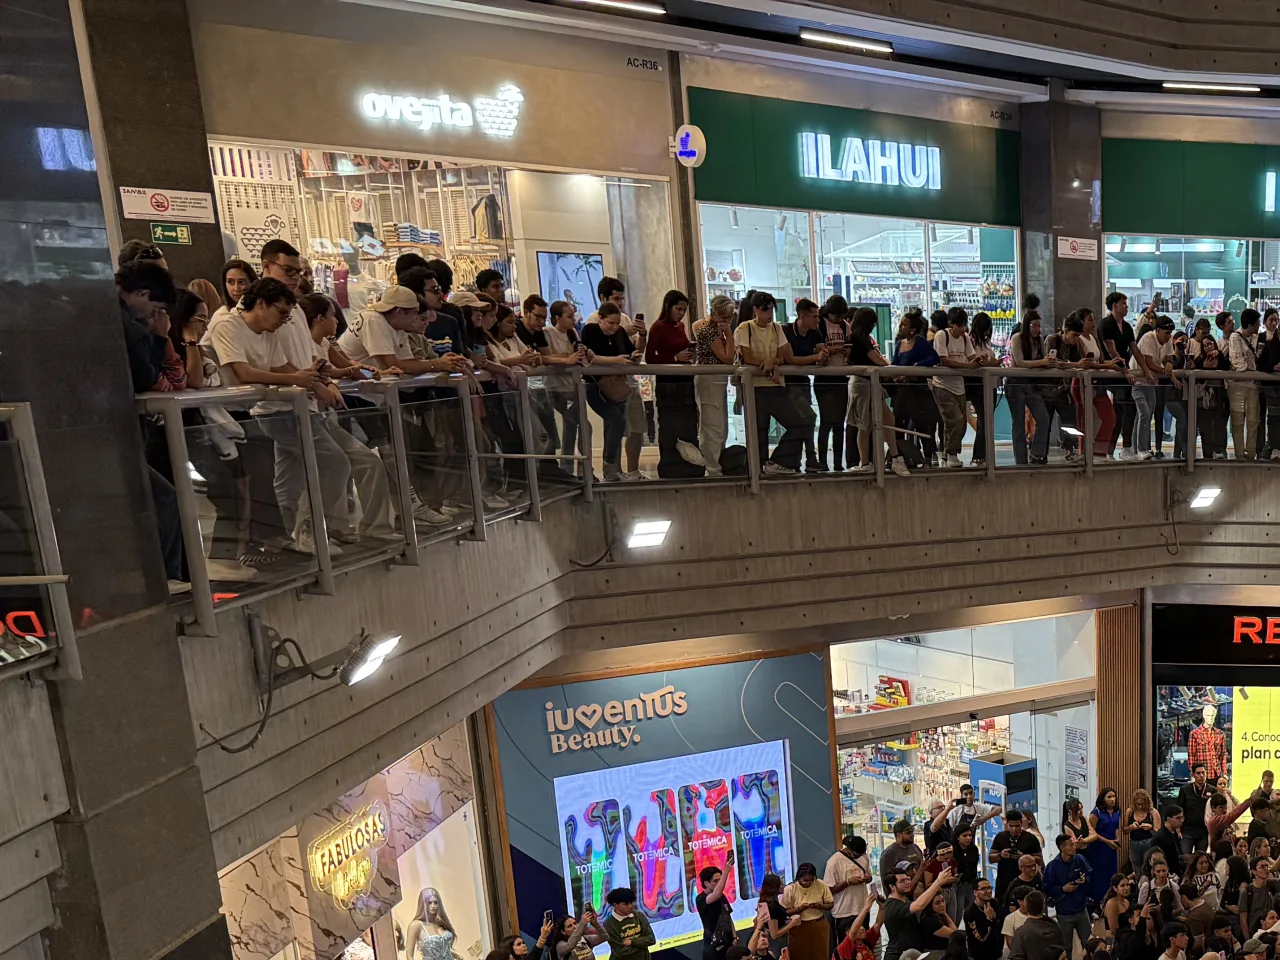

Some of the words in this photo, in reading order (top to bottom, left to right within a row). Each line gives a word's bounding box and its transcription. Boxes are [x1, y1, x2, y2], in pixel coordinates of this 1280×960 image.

[626, 57, 658, 71] AC-R36
[362, 92, 474, 130] ovejita
[797, 132, 941, 189] ILAHUI
[550, 724, 641, 754] Beauty.
[1241, 732, 1249, 743] 4.
[1241, 746, 1270, 763] plan
[321, 812, 385, 877] FABULOSAS
